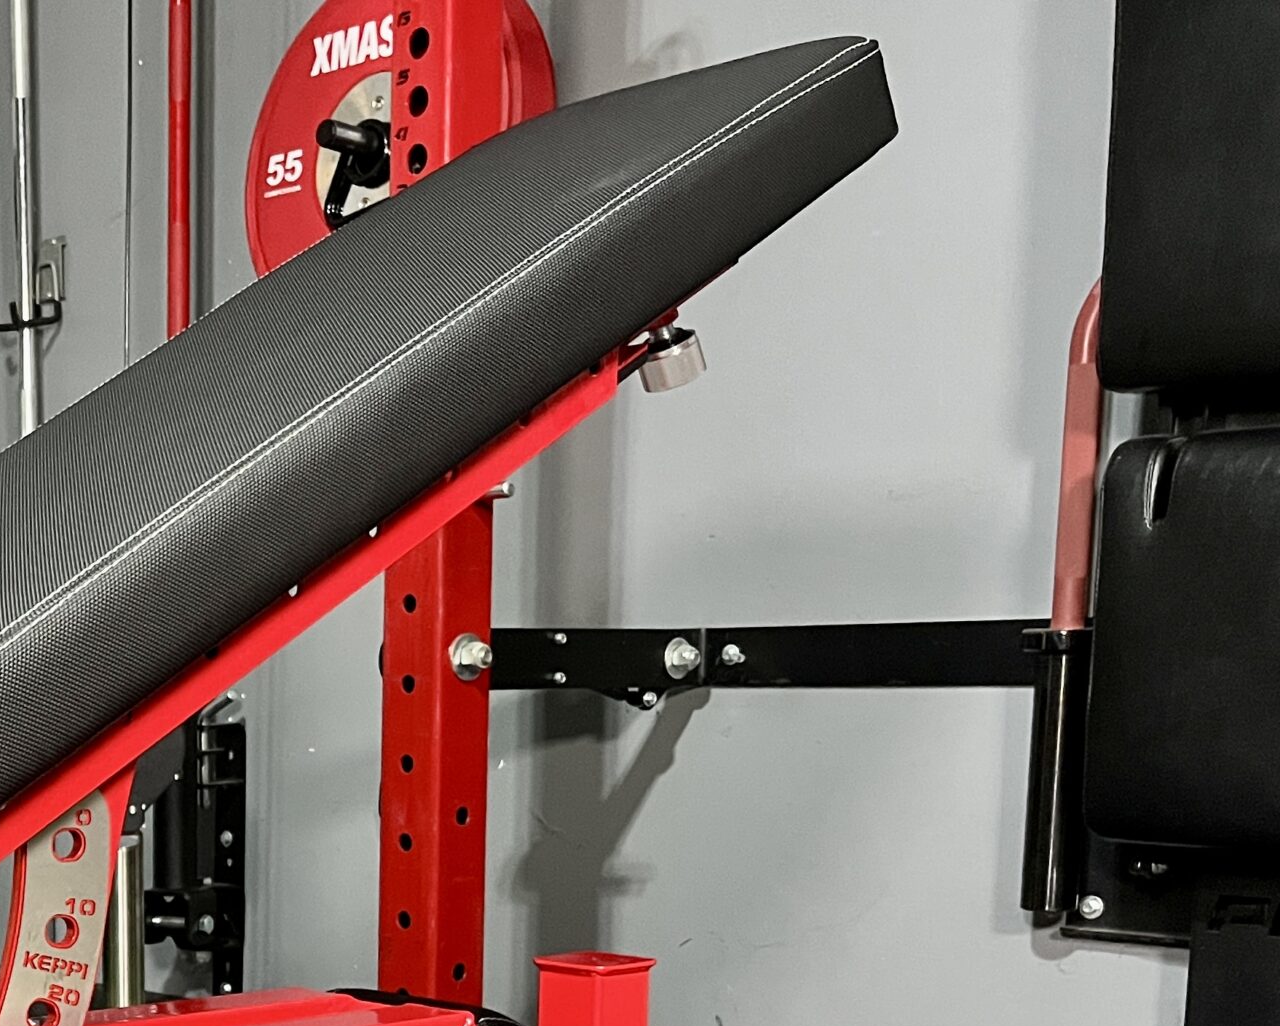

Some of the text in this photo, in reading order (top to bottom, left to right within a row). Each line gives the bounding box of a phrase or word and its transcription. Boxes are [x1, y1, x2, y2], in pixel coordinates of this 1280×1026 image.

[266, 148, 303, 186] 55
[76, 809, 91, 825] 0
[65, 898, 96, 916] 10
[23, 951, 89, 980] KEPPI
[47, 984, 81, 1007] 20
